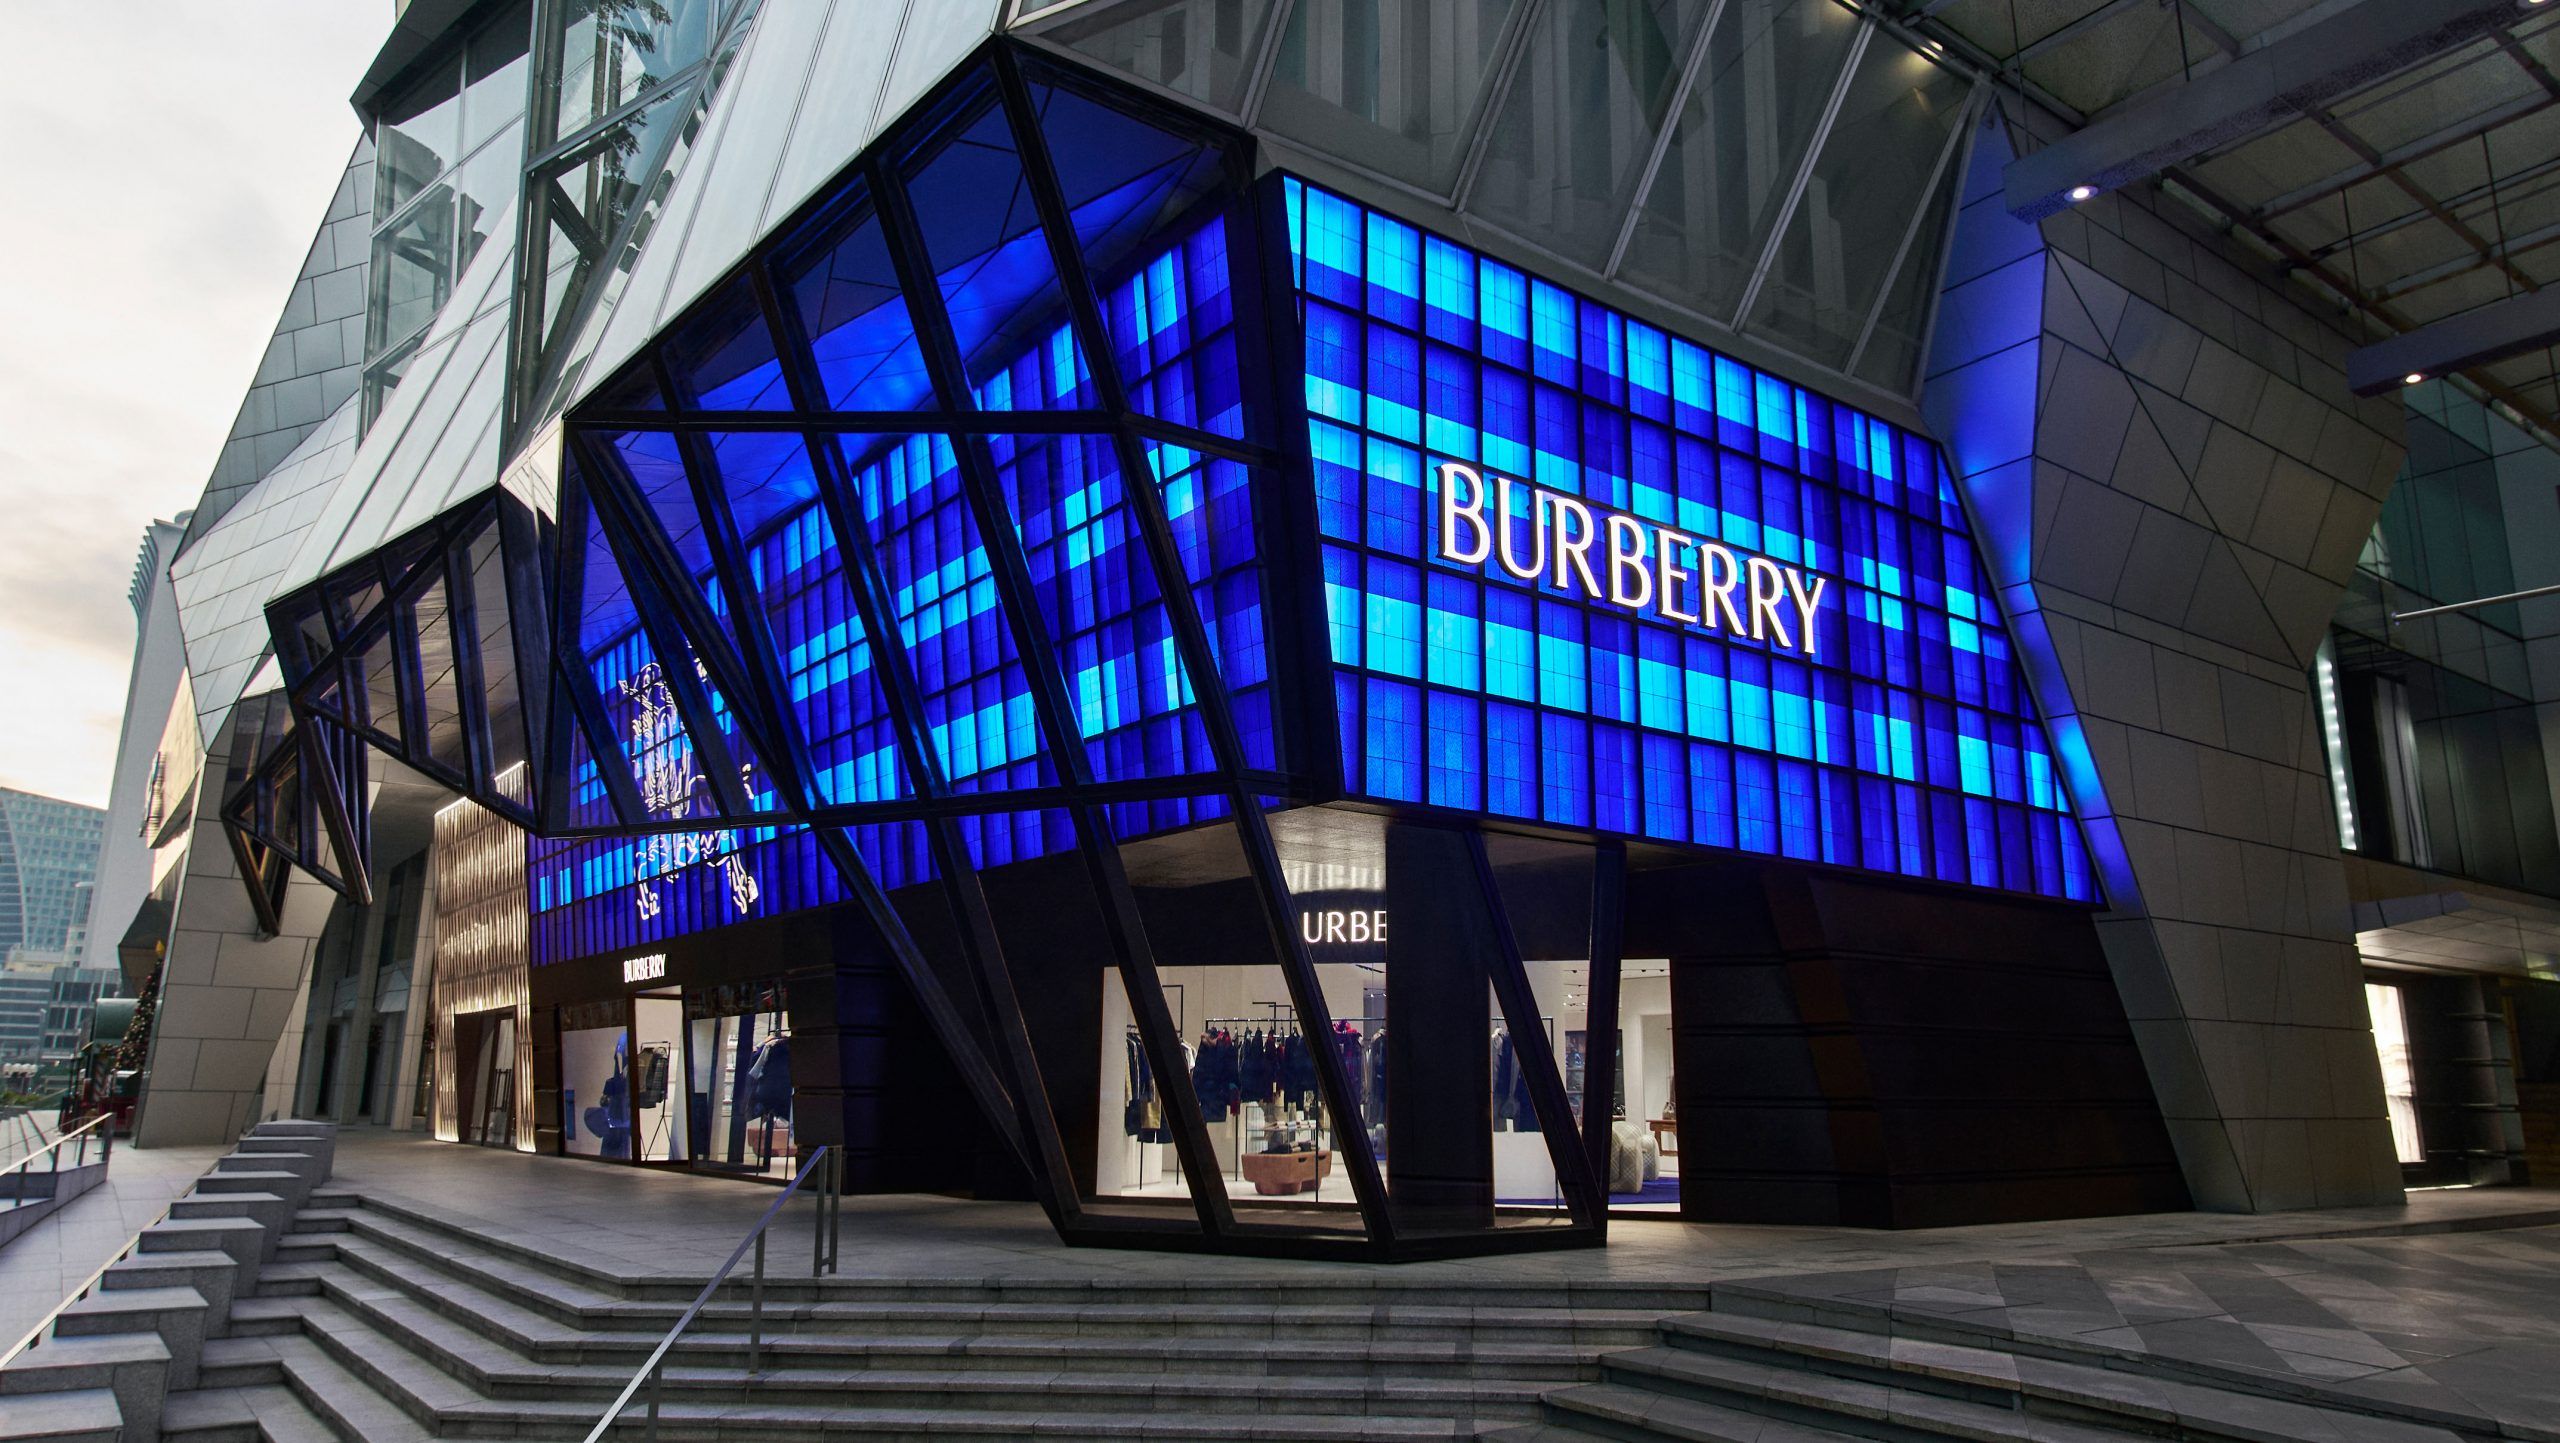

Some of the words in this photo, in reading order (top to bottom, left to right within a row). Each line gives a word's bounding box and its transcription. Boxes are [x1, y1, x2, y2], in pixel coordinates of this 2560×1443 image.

[1438, 462, 1827, 655] BURBERRY
[1303, 910, 1387, 943] URBE
[623, 953, 667, 983] BURBERRY
